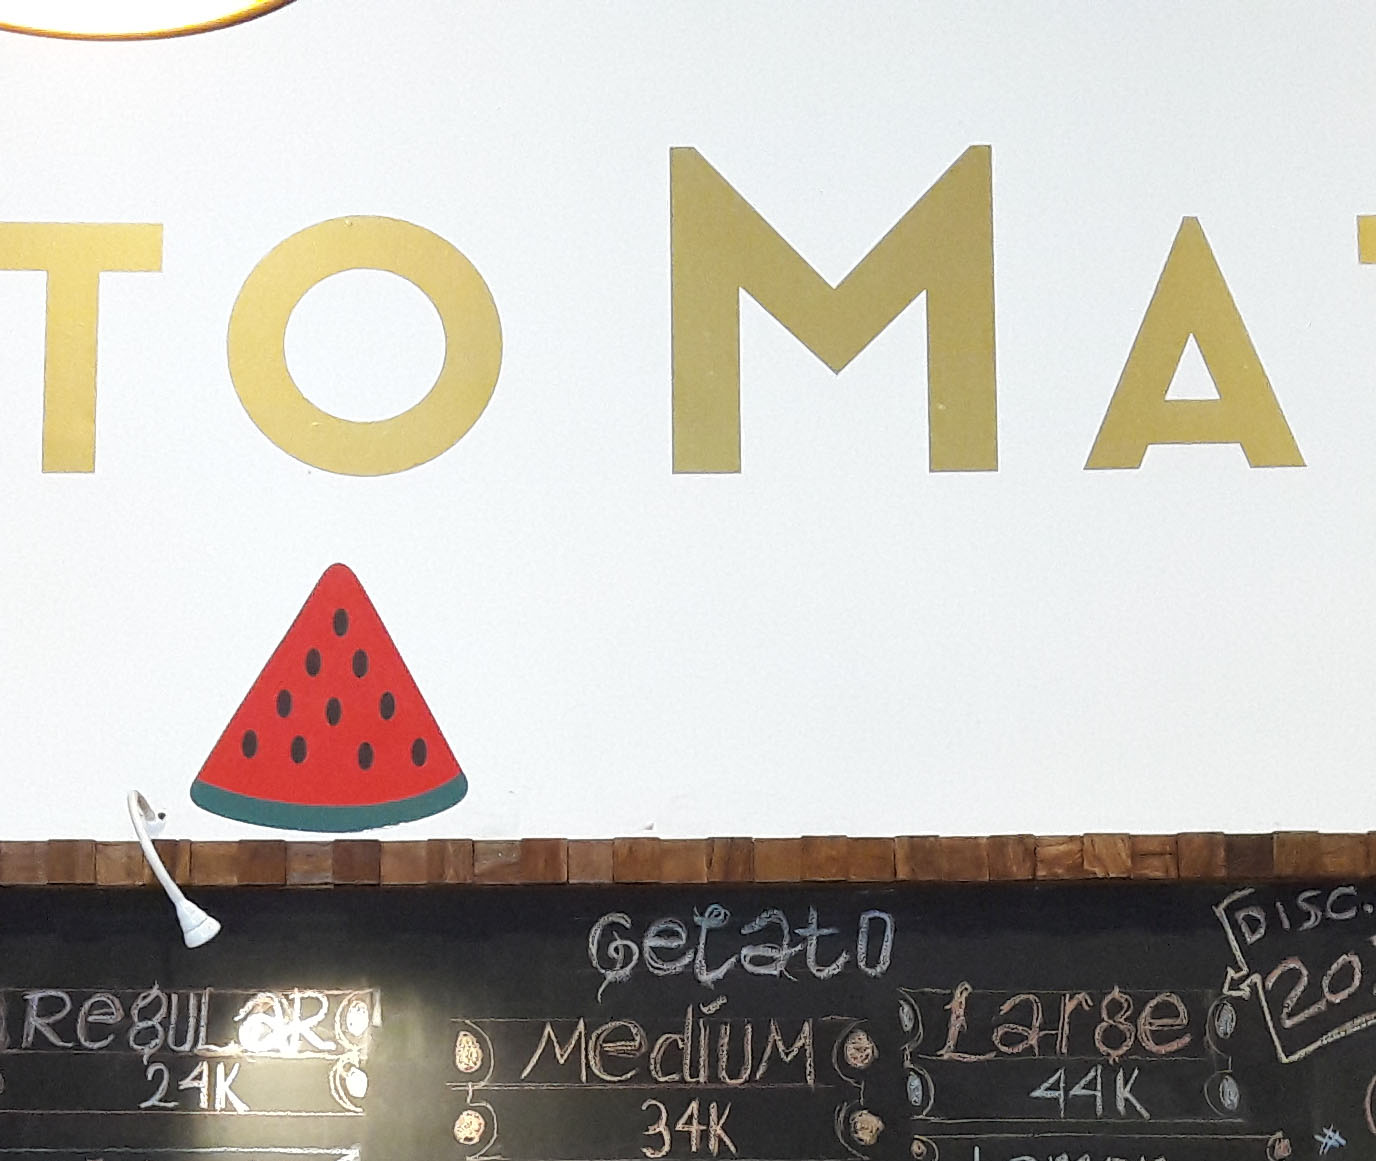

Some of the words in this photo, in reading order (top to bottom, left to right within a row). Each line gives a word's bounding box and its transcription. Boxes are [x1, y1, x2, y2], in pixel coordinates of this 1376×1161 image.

[138, 1062, 251, 1114] 24K
[1029, 1065, 1152, 1122] 44K
[640, 1098, 738, 1159] 34K
